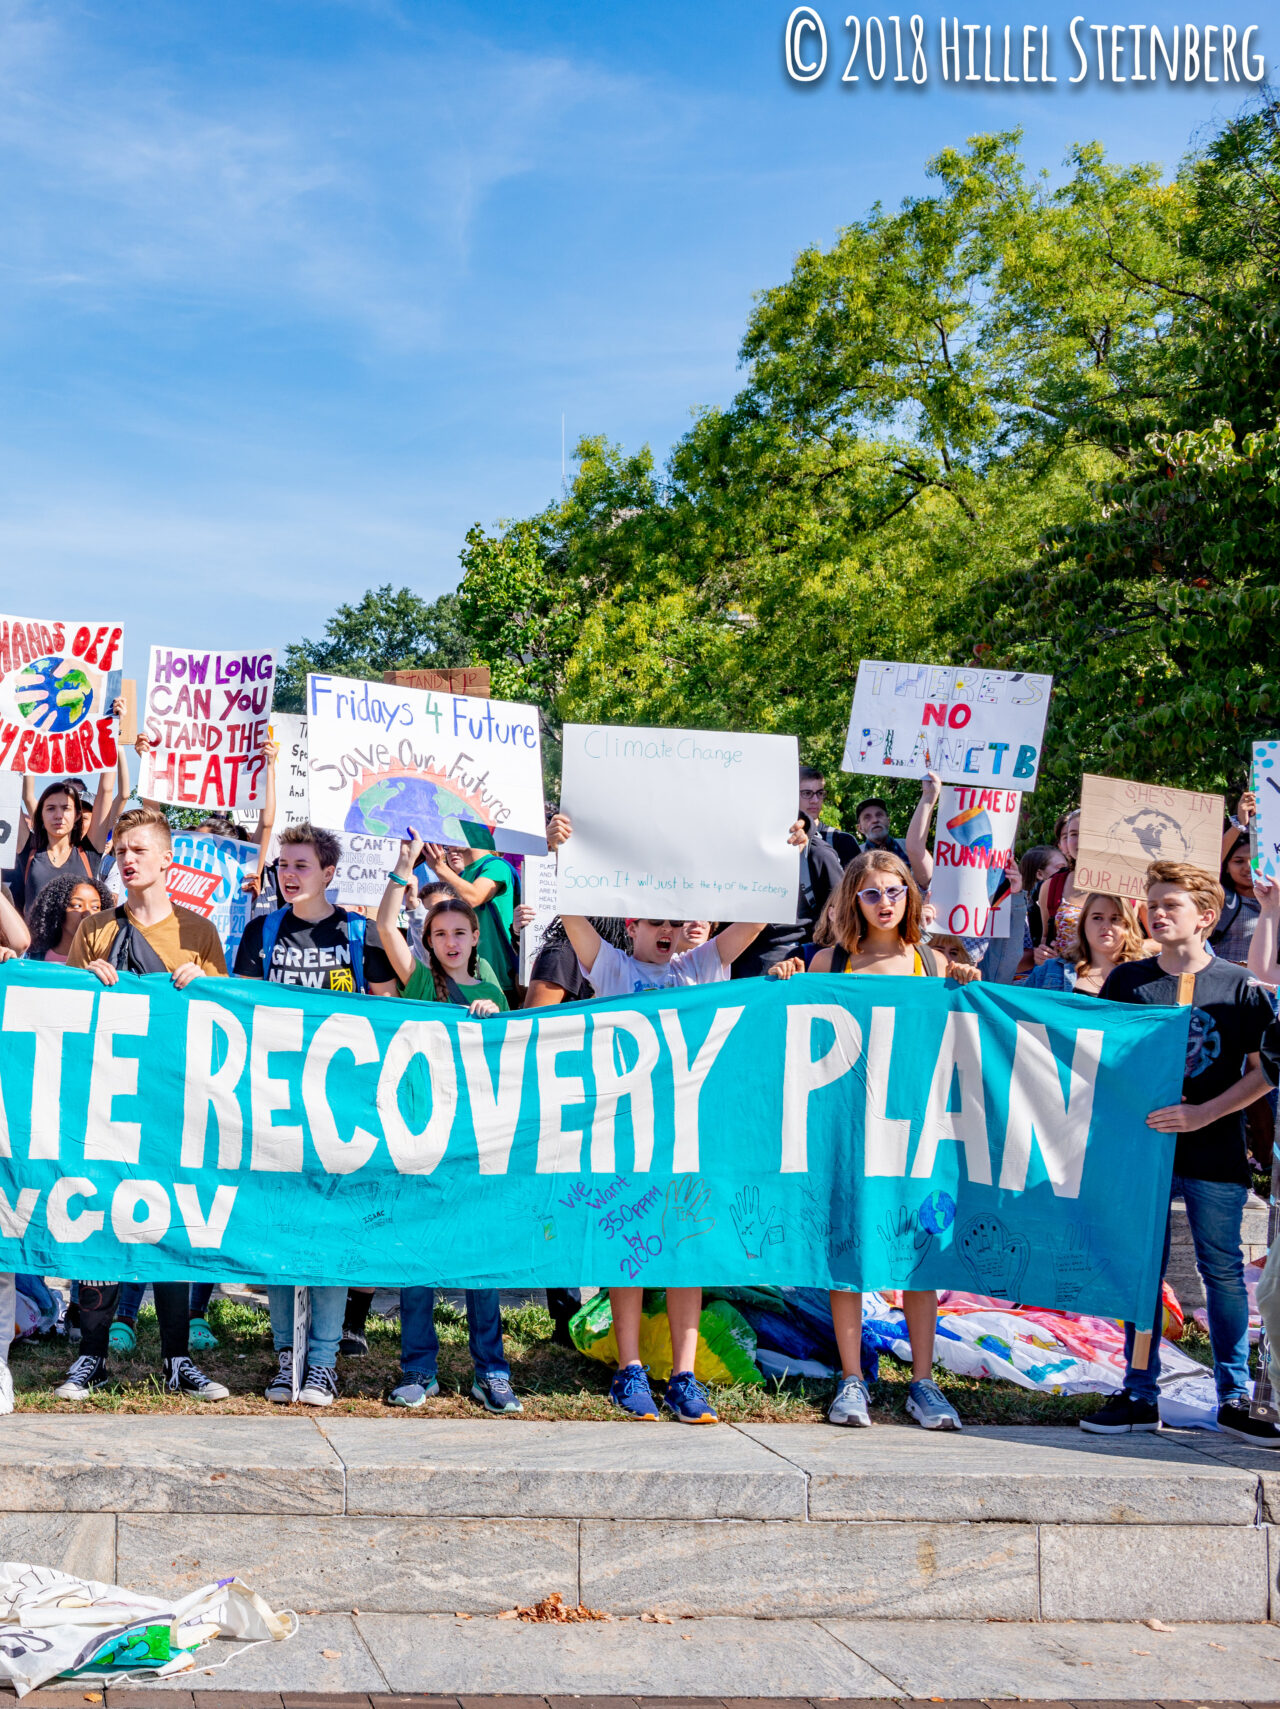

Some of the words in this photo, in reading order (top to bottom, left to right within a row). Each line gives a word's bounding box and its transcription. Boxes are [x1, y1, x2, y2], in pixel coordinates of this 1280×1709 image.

[72, 626, 122, 671] OFF
[155, 650, 210, 684] HOW
[215, 654, 273, 685] LONG
[865, 663, 1044, 705] THERE'S
[149, 684, 211, 720] CAN
[219, 686, 268, 721] YOU
[310, 675, 414, 733] Fridays
[425, 692, 443, 734] 4
[452, 697, 537, 748] Future
[922, 703, 971, 729] NO
[11, 716, 118, 774] FUTURE
[145, 716, 222, 752] STAND
[227, 719, 268, 753] THE
[584, 730, 672, 759] Climate
[676, 738, 744, 768] Change
[858, 727, 1010, 775] PLANET
[1012, 744, 1037, 778] B
[147, 751, 267, 807] HEAT?
[291, 765, 306, 777] The
[309, 743, 390, 791] Save
[398, 738, 435, 769] Our
[447, 752, 511, 824] Future
[289, 785, 304, 797] And
[954, 787, 1003, 812] TIME
[1006, 791, 1017, 813] IS
[1124, 784, 1176, 807] SHE'S
[1188, 792, 1213, 814] IN
[285, 811, 309, 822] Trees
[936, 841, 1012, 869] RUNNING
[165, 867, 216, 898] STRIKE
[564, 866, 609, 888] Soon
[613, 870, 630, 888] It
[682, 877, 694, 889] be
[1077, 866, 1112, 890] OUR
[948, 904, 1000, 937] OUT
[271, 944, 351, 967] GREEN
[268, 968, 325, 989] NEW
[180, 999, 746, 1176] RECOVERY
[780, 1003, 1104, 1199] PLAN
[558, 1181, 593, 1208] We
[585, 1175, 632, 1210] Want
[620, 1235, 662, 1279] 2100
[622, 1231, 645, 1249] by
